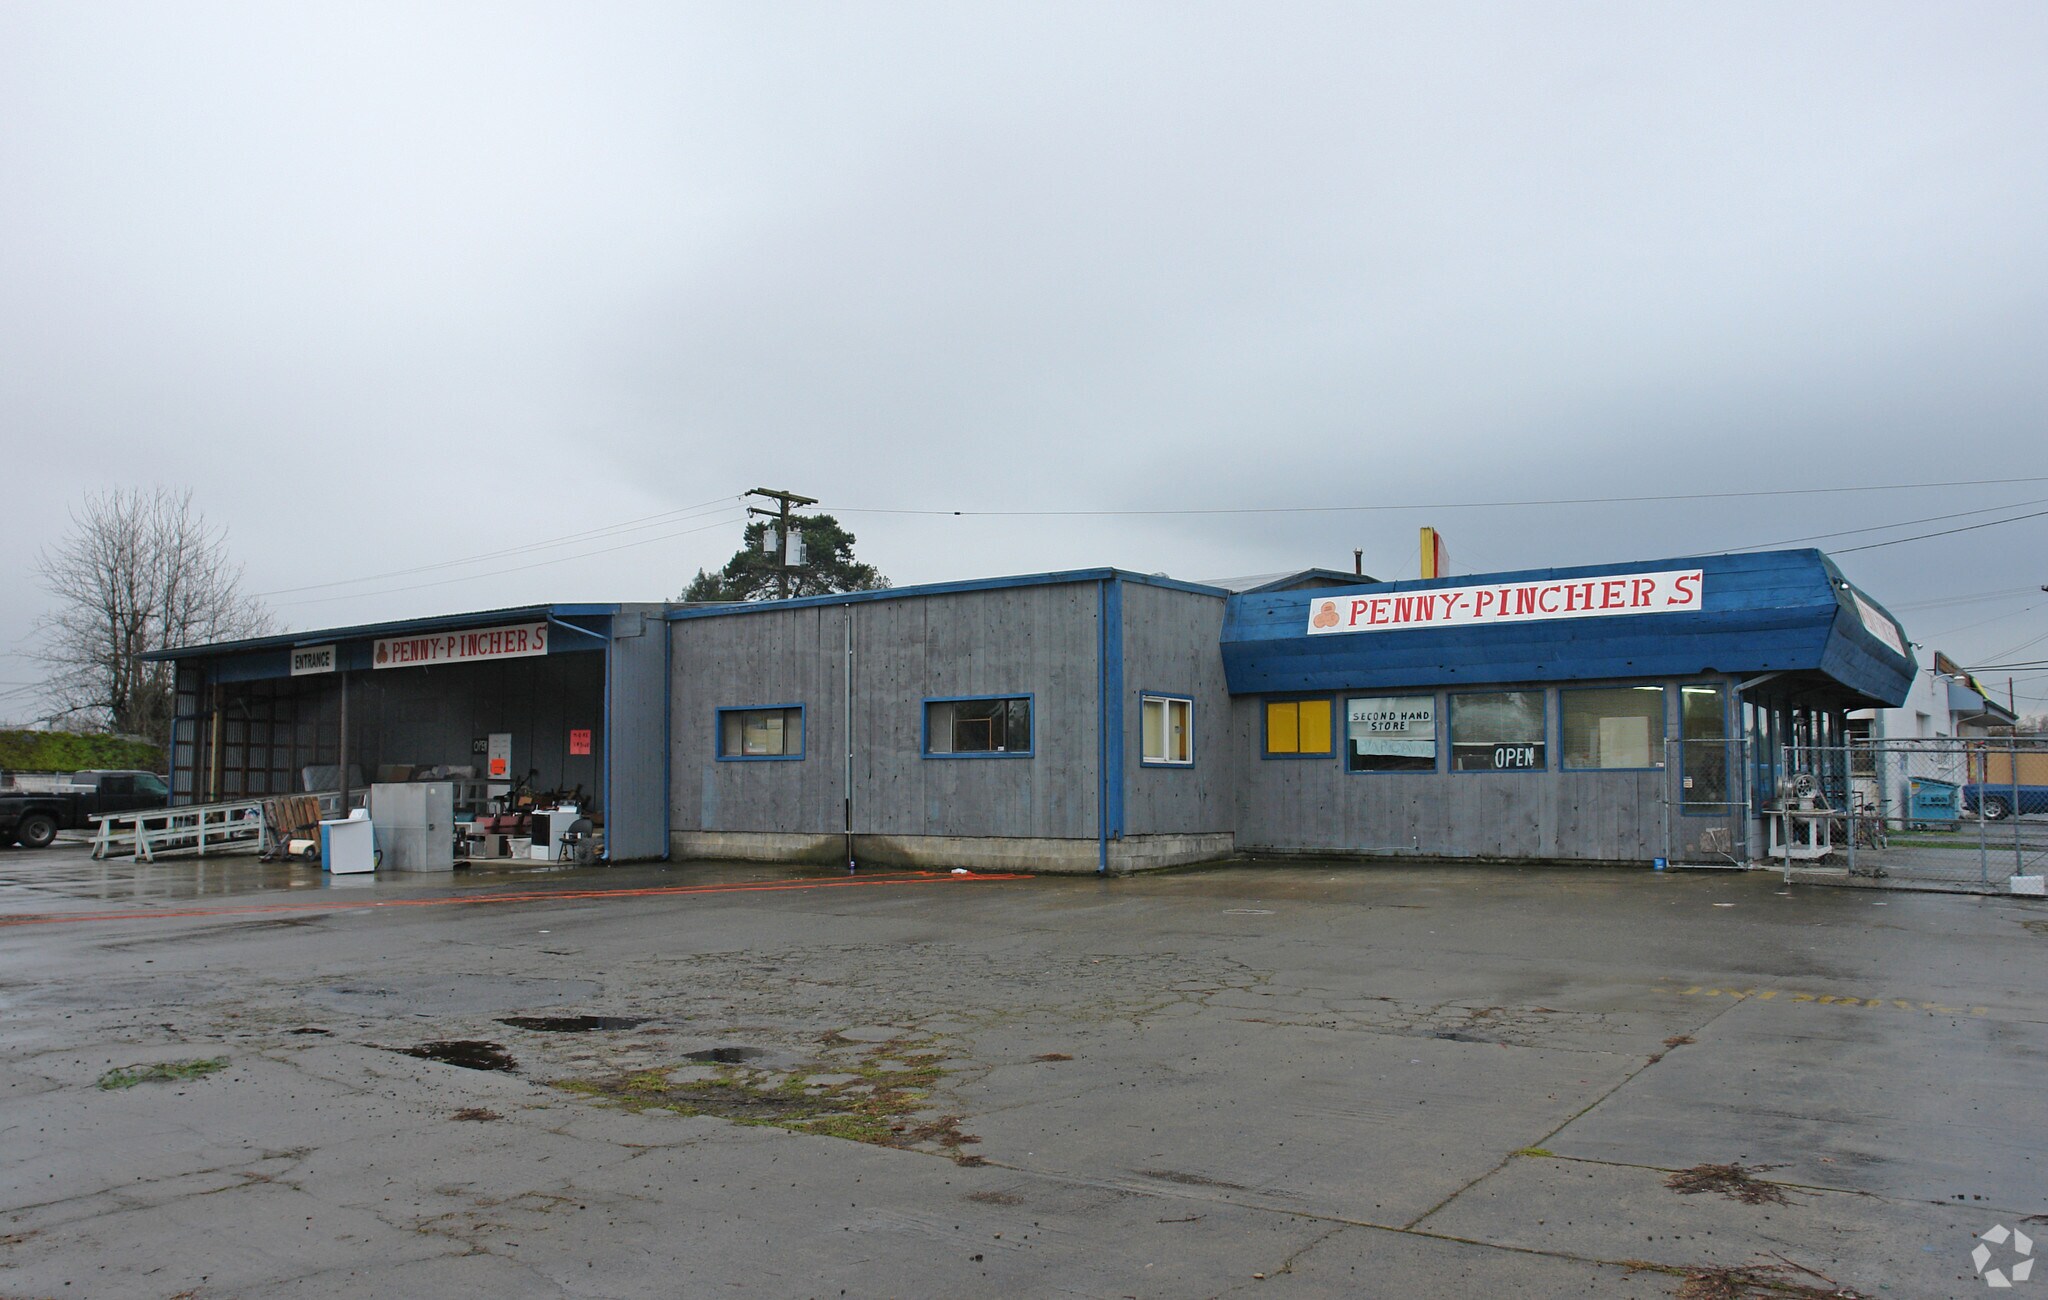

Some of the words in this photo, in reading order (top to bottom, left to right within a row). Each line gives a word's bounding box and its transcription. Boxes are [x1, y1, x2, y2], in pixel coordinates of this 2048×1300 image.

[295, 651, 329, 669] ENTRANCE
[1353, 712, 1395, 721] SECOND
[1401, 711, 1429, 720] HAND
[1371, 722, 1405, 730] STORE
[473, 740, 488, 752] OPEN
[1495, 747, 1534, 768] OPEN
